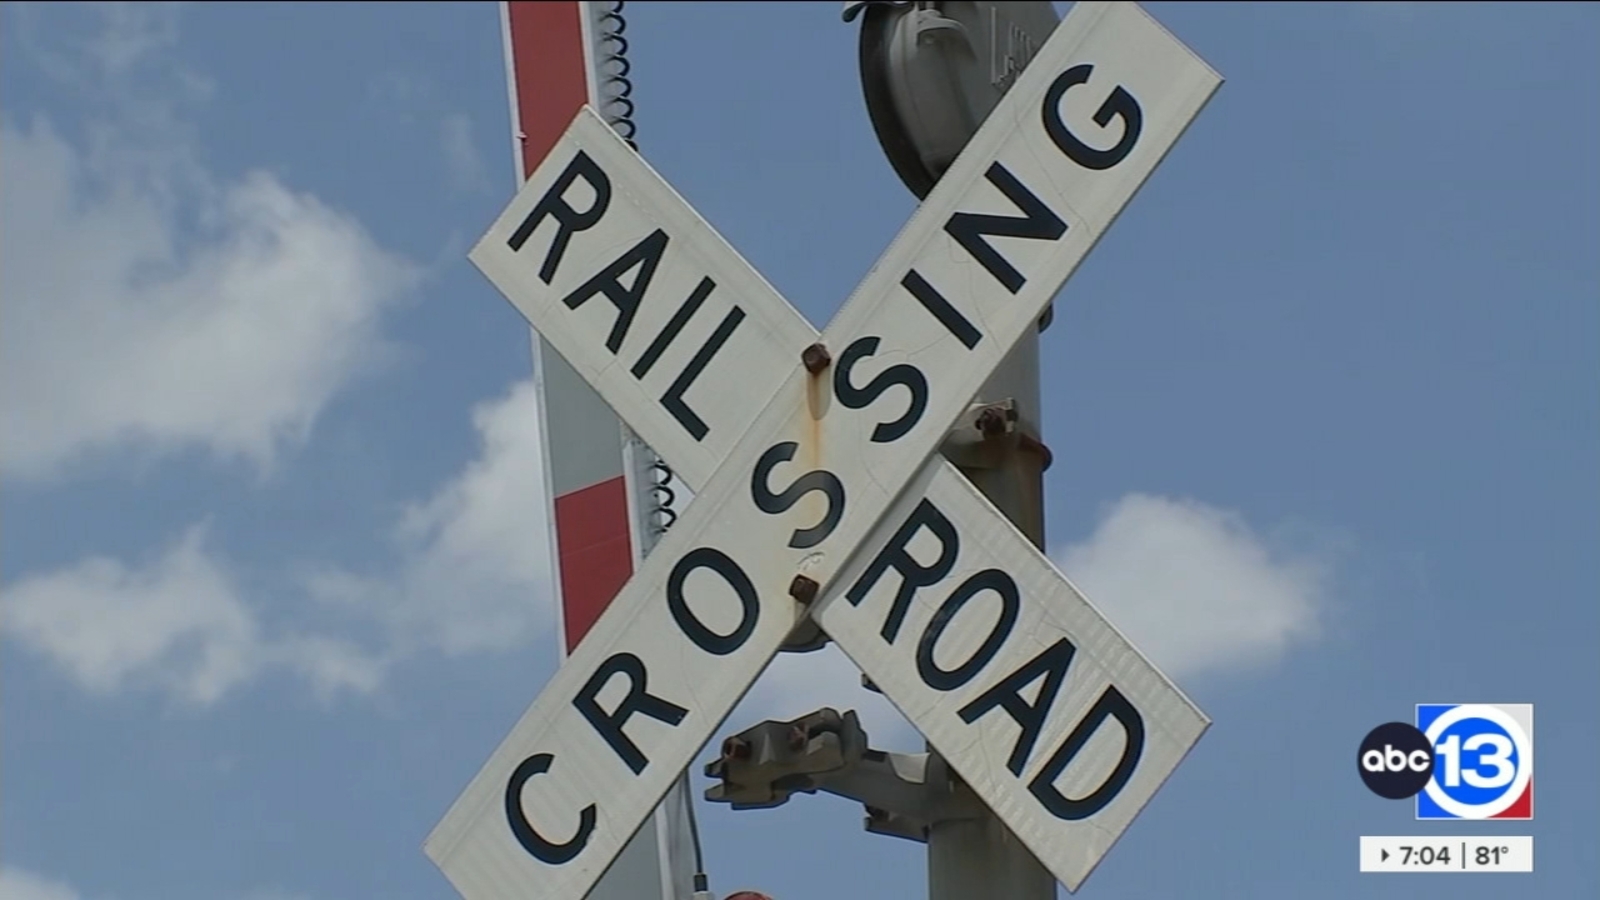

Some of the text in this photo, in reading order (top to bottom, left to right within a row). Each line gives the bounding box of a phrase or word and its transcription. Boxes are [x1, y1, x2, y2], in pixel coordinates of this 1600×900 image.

[504, 64, 1143, 865] CROSSING
[506, 149, 1145, 821] RAIL ROAD
